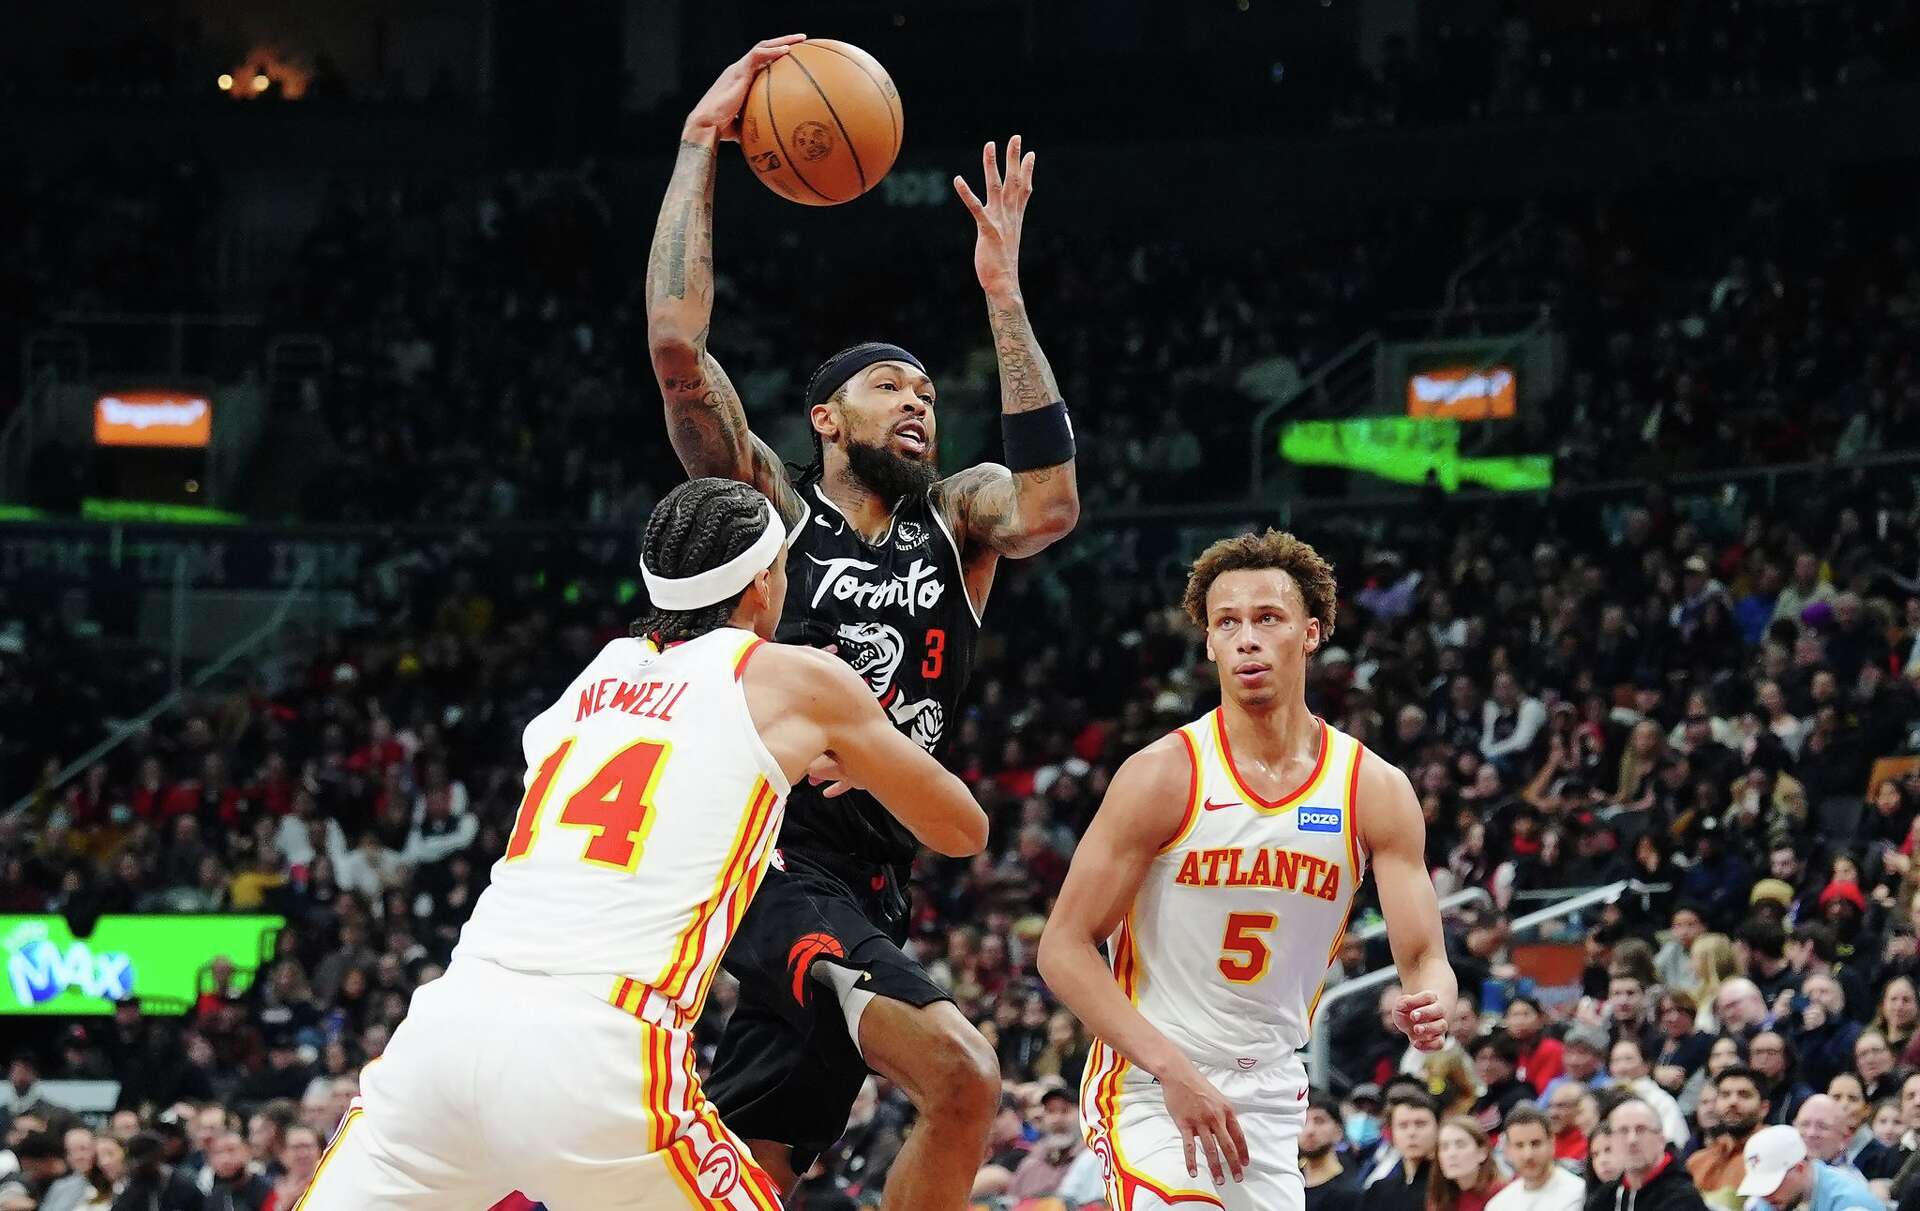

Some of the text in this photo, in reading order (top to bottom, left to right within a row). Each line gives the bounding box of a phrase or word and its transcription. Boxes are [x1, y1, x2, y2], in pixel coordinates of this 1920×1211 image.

[894, 532, 930, 551] Sun Life
[804, 551, 945, 617] Toronto
[921, 628, 945, 679] 3
[575, 677, 689, 722] NEWELL
[505, 735, 672, 877] 14
[1299, 812, 1340, 826] paze
[1173, 847, 1342, 902] ATLANTA
[1217, 911, 1278, 985] 5
